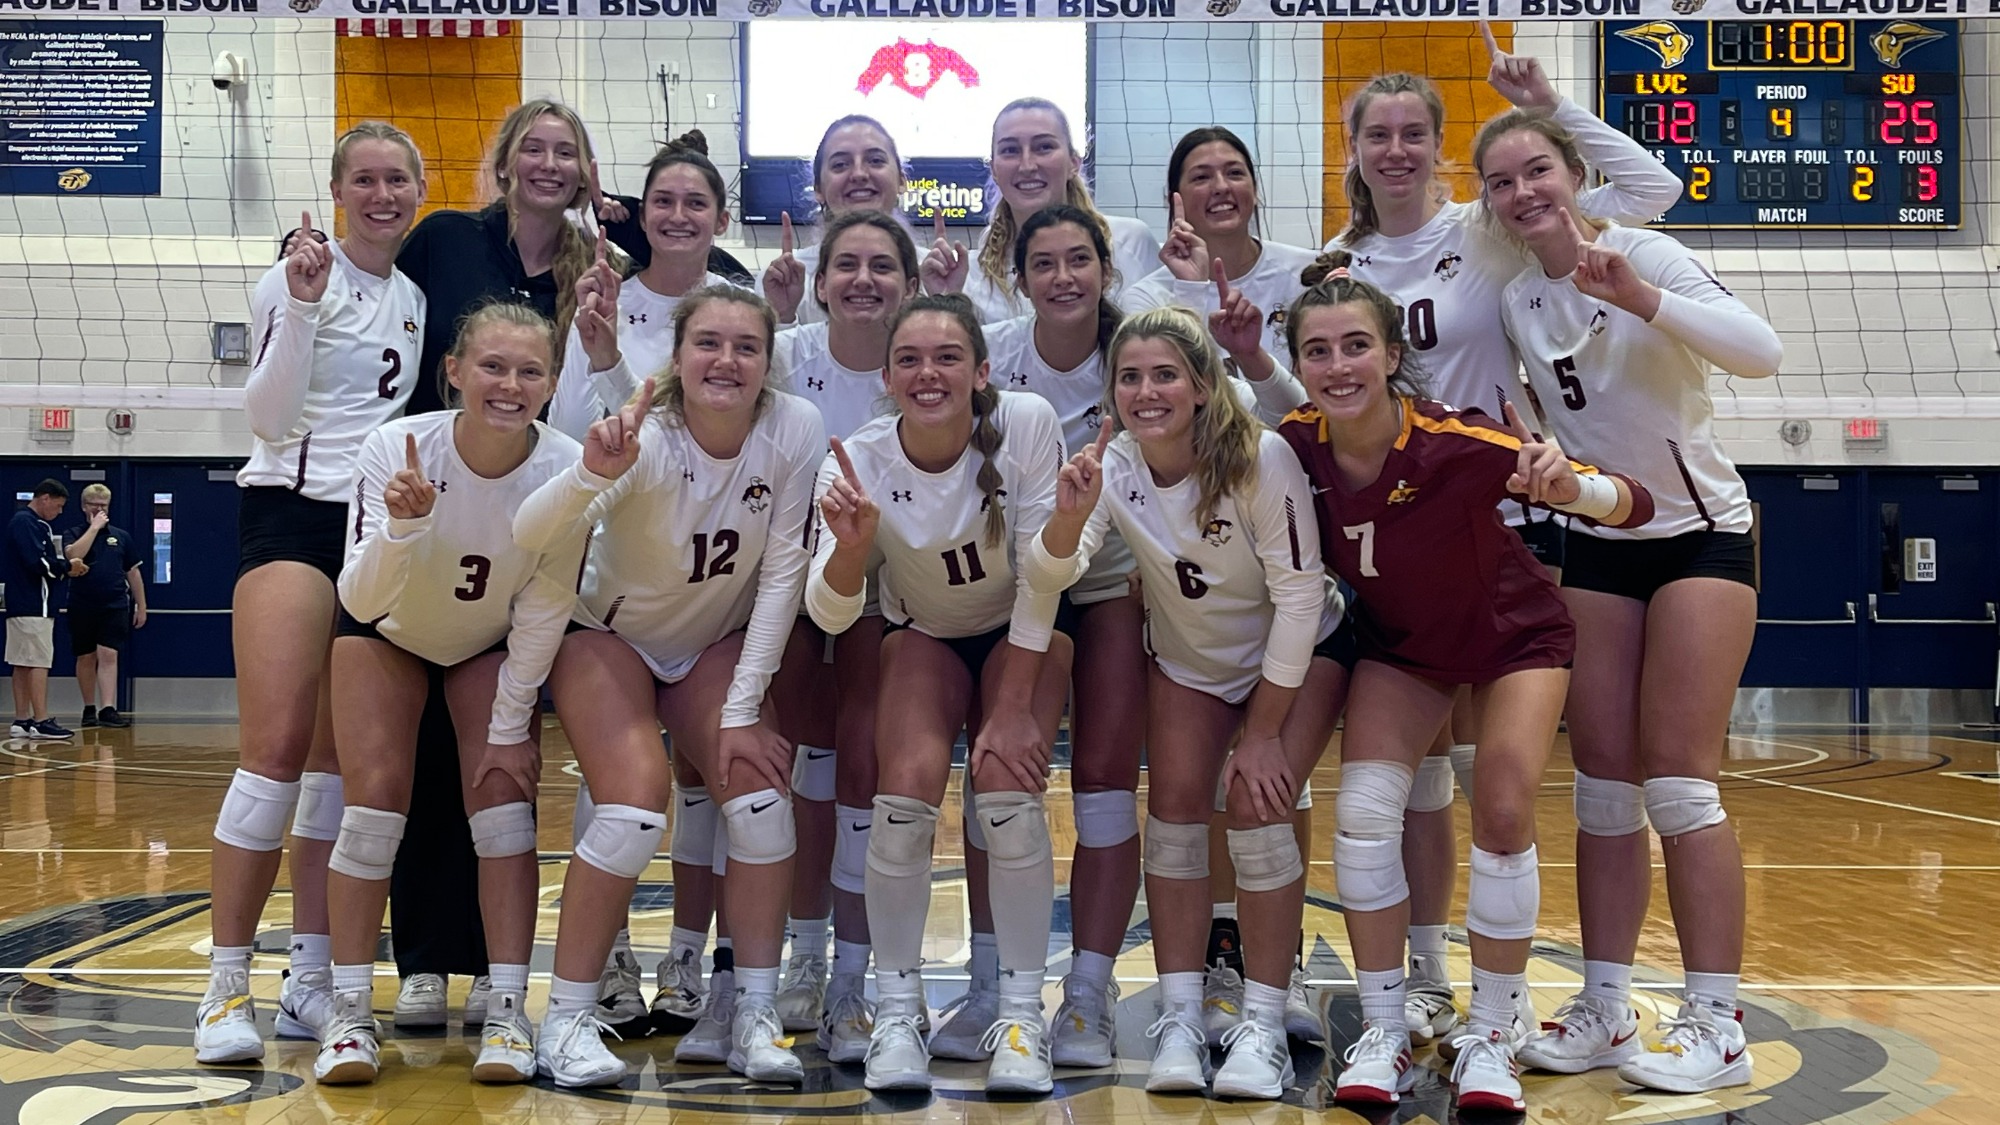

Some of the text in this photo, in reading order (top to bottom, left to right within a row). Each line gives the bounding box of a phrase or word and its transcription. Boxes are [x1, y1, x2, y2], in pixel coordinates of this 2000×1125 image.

[600, 0, 717, 16] BISON
[810, 0, 1175, 18] GALLAUDET BISON
[1270, 0, 1640, 17] GALLAUDET BISON
[1737, 0, 1967, 15] GALLAUDET
[1635, 73, 1688, 94] LVC
[1756, 85, 1807, 100] PERIOD
[1881, 73, 1916, 94] SU
[1771, 108, 1792, 137] 4
[1881, 101, 1938, 144] 25
[1681, 150, 1720, 164] T.O.L.
[1733, 149, 1831, 165] PLAYER FOUL
[1898, 150, 1943, 164] FOULS
[1689, 166, 1711, 201] 2
[1852, 166, 1874, 201] 2
[1918, 166, 1938, 201] 3
[1758, 208, 1807, 223] MATCH
[1898, 208, 1945, 222] SCORE
[378, 348, 401, 400] 2
[1553, 355, 1587, 411] 5
[45, 409, 70, 429] EXIT
[687, 529, 740, 584] 12
[1342, 520, 1380, 578] 7
[941, 540, 987, 586] 11
[1917, 562, 1934, 571] EXIT
[454, 554, 491, 601] 3
[1174, 559, 1209, 600] 6
